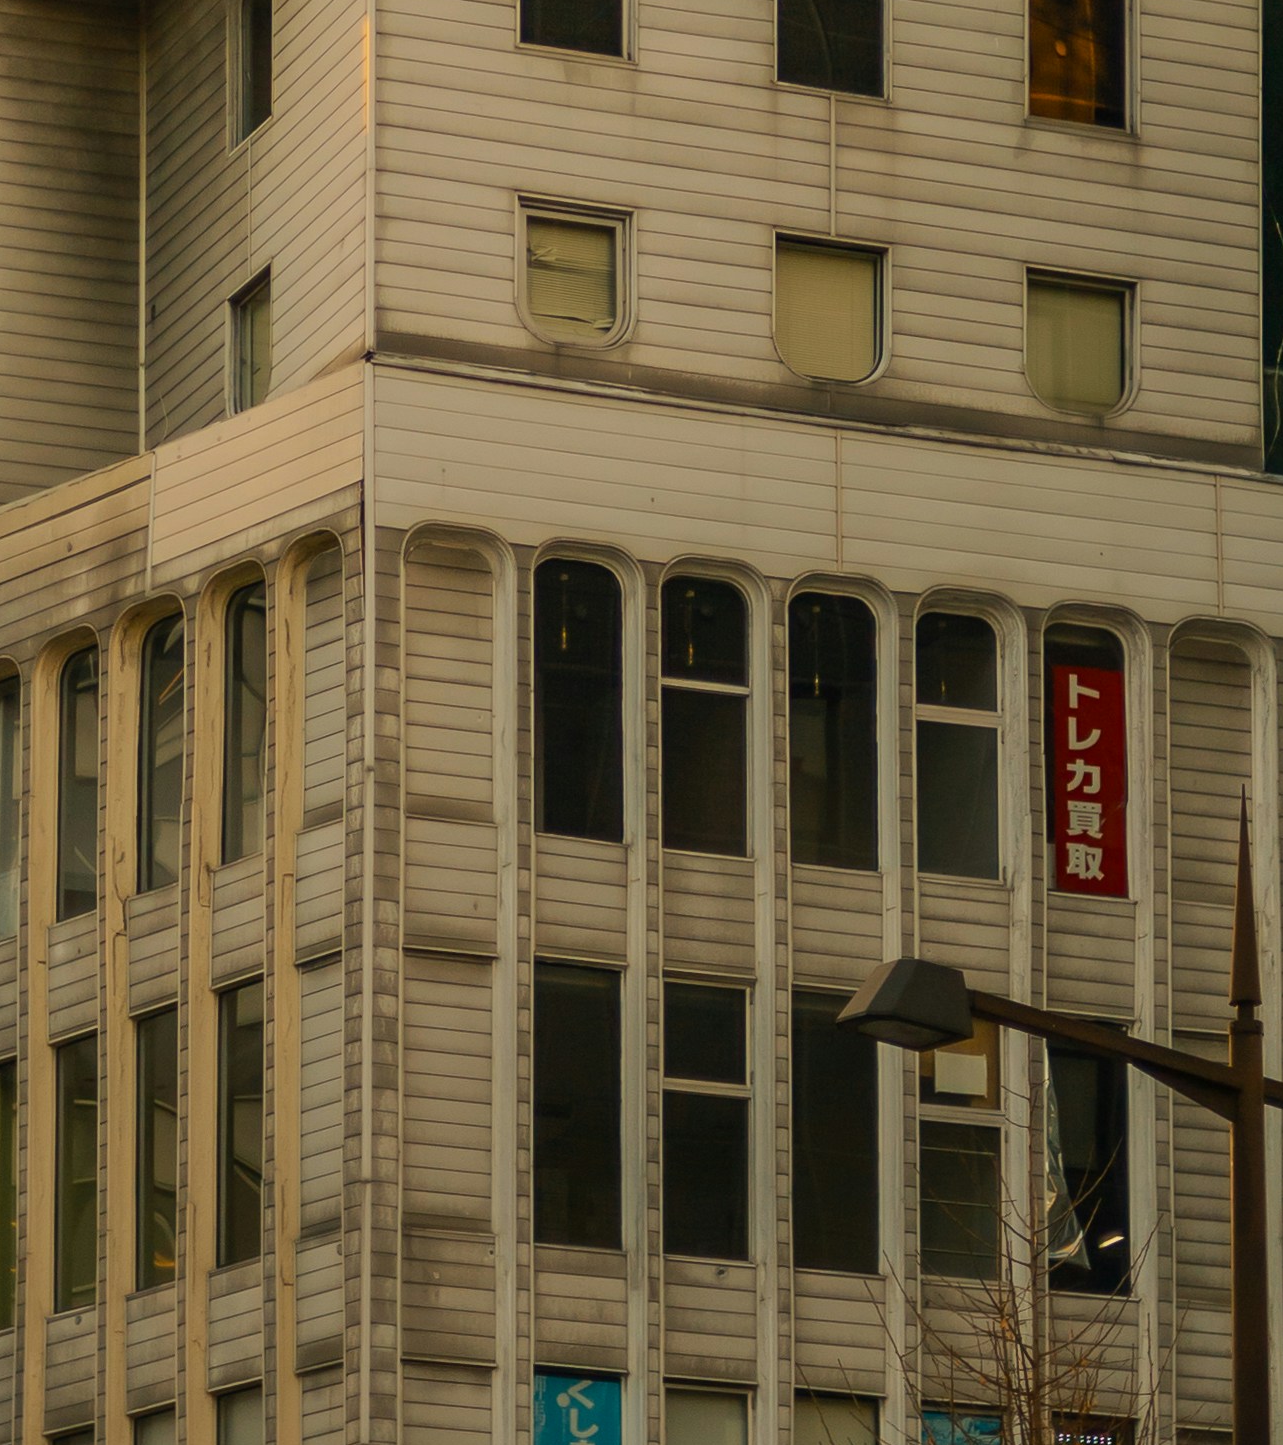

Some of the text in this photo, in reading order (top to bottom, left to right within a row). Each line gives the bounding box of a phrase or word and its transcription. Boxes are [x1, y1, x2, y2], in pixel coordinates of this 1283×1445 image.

[1066, 674, 1105, 882] トレカ買取
